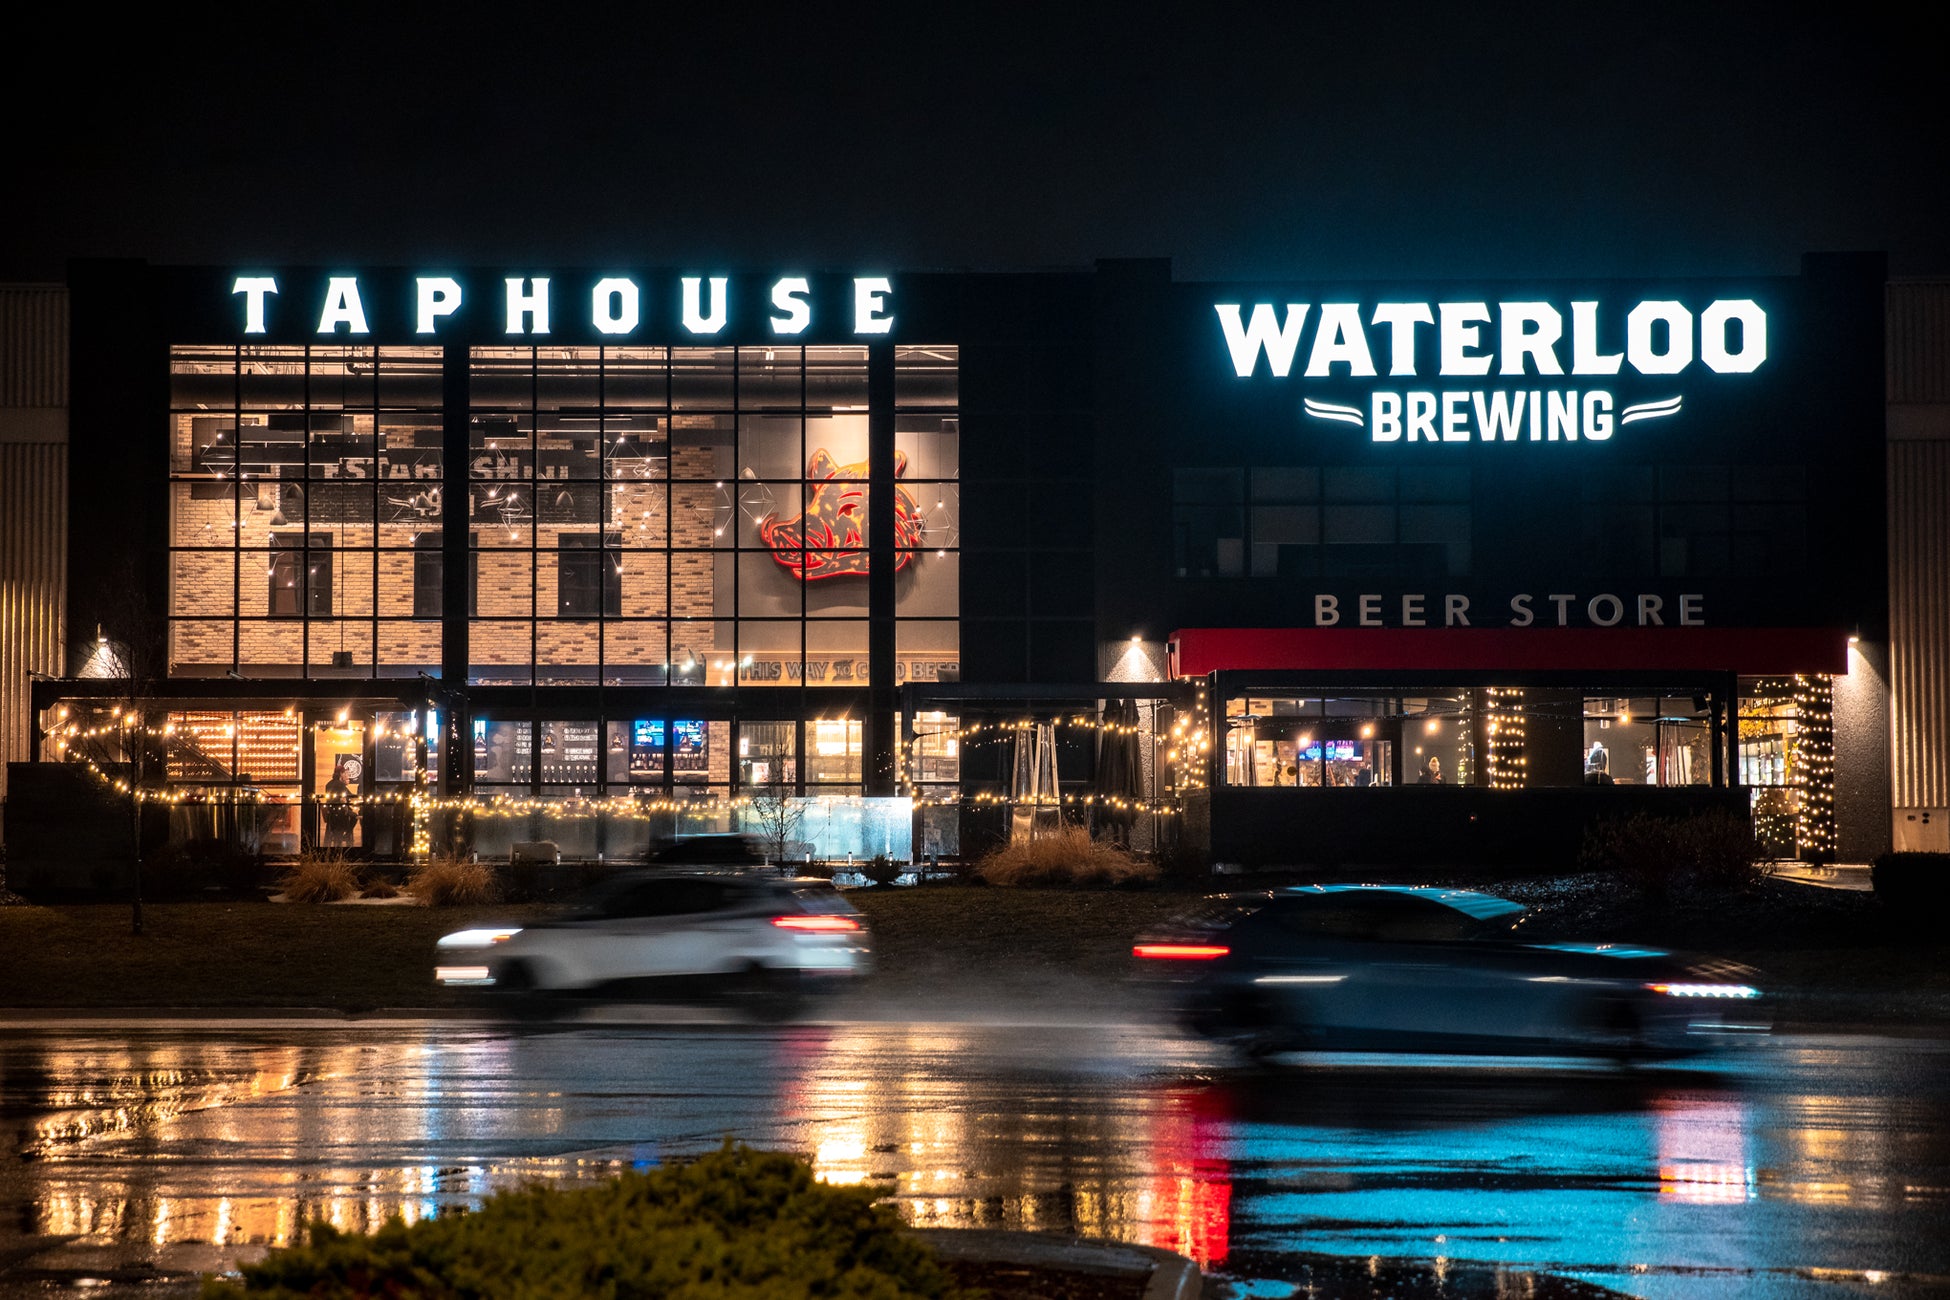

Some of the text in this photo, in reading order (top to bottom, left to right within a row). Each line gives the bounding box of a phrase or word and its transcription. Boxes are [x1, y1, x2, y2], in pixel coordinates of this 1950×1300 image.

[232, 277, 894, 335] TAPHOUSE
[1214, 299, 1768, 378] WATERLOO
[1371, 390, 1614, 443] BREWING
[1315, 593, 1705, 627] BEER STORE
[740, 662, 782, 681] THIS
[785, 661, 829, 680] WAY
